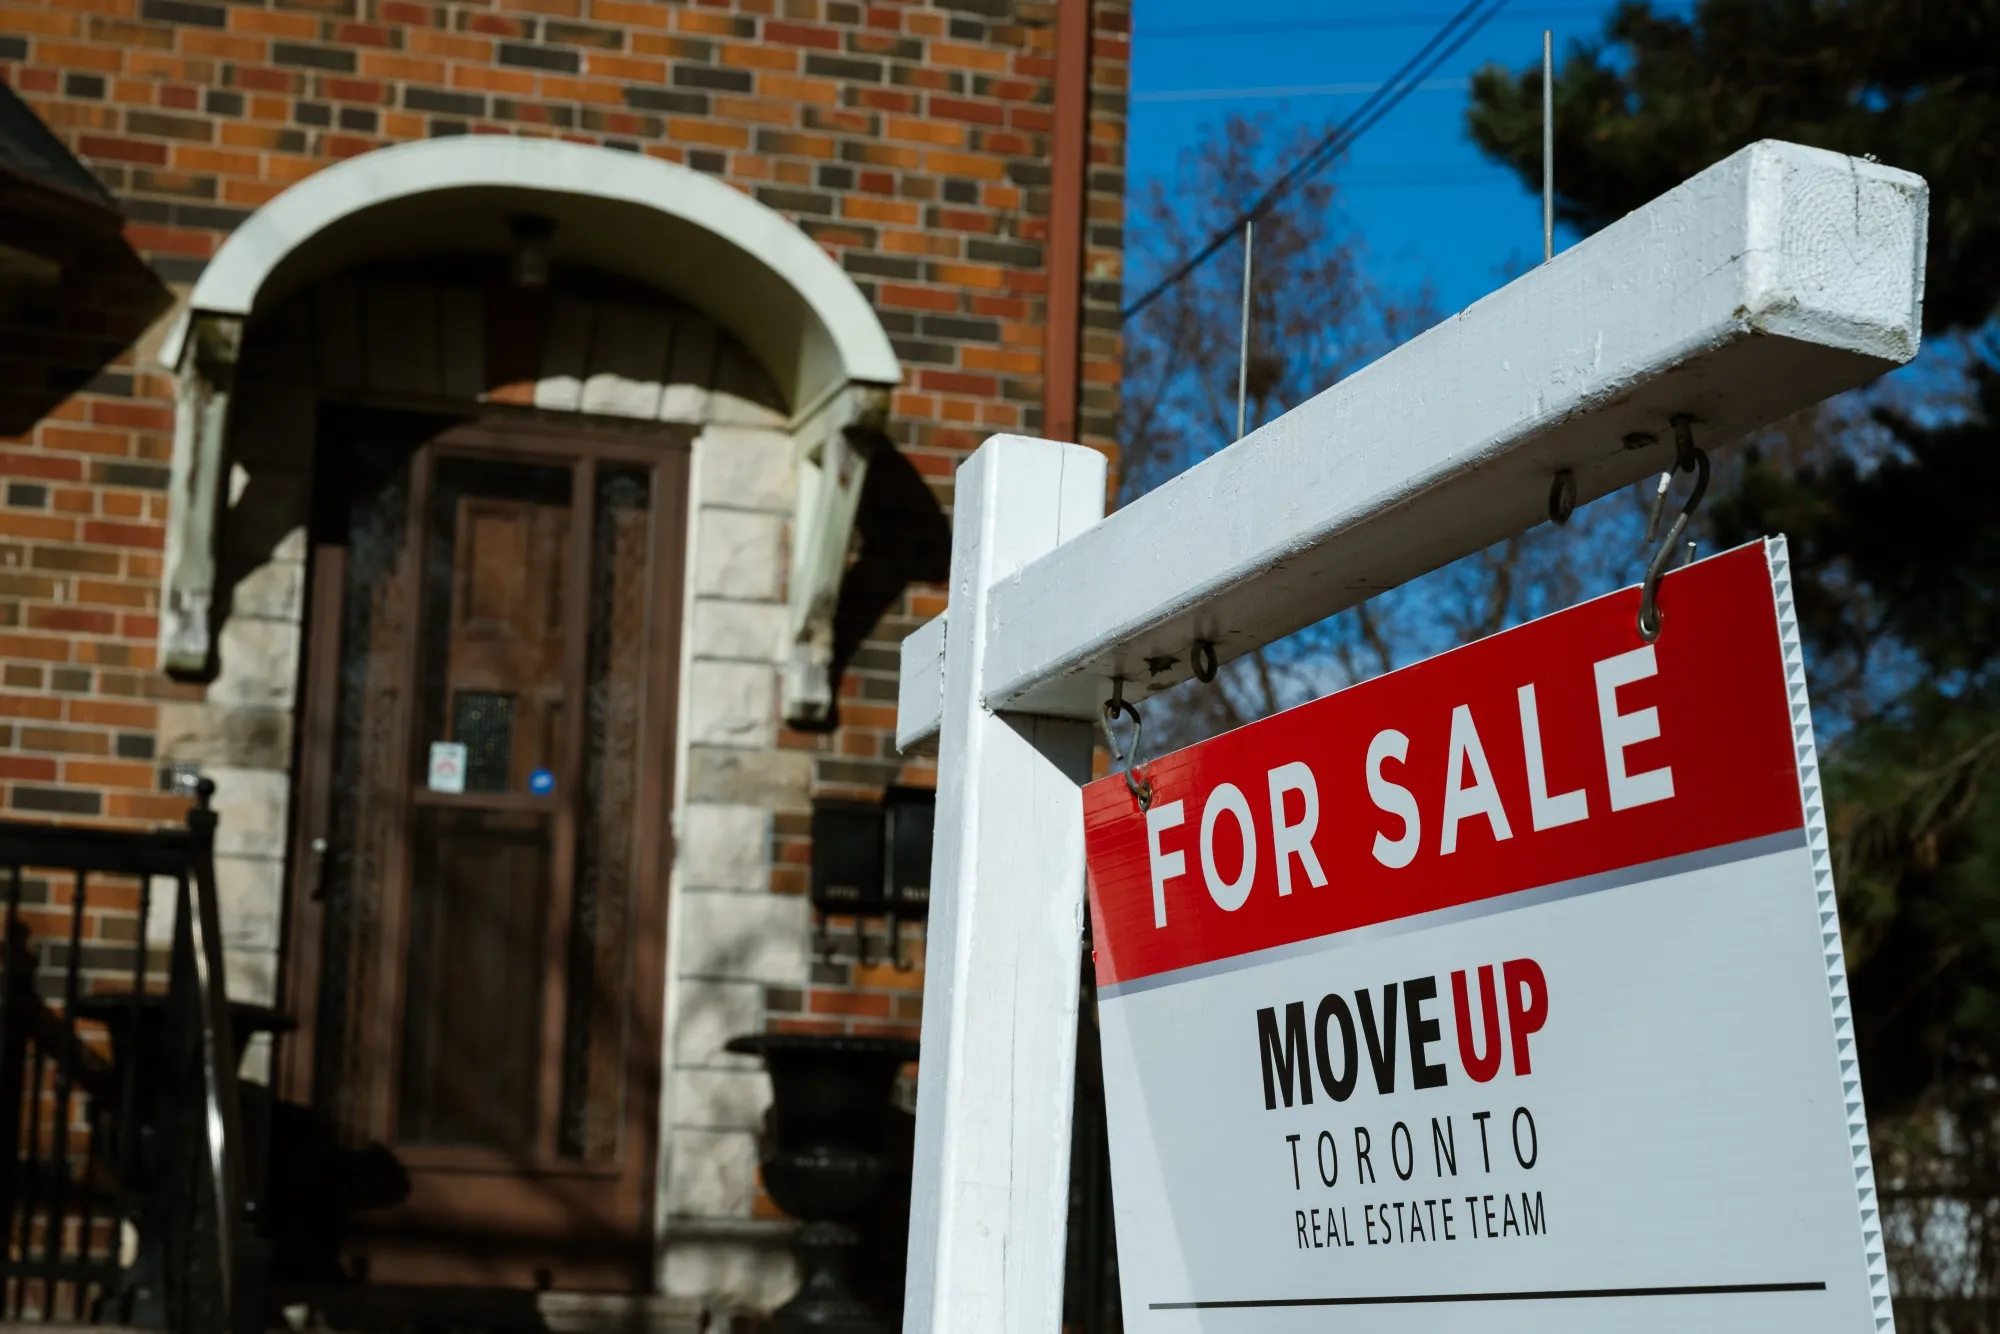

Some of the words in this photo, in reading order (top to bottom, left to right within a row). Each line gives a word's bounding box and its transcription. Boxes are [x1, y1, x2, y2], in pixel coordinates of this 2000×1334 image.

[1146, 761, 1328, 928] FOR
[1365, 644, 1675, 868] SALE
[1286, 1106, 1538, 1190] TORONTO
[1296, 1206, 1355, 1249] REAL
[1364, 1198, 1457, 1245] ESTATE
[1465, 1191, 1547, 1239] TEAM
